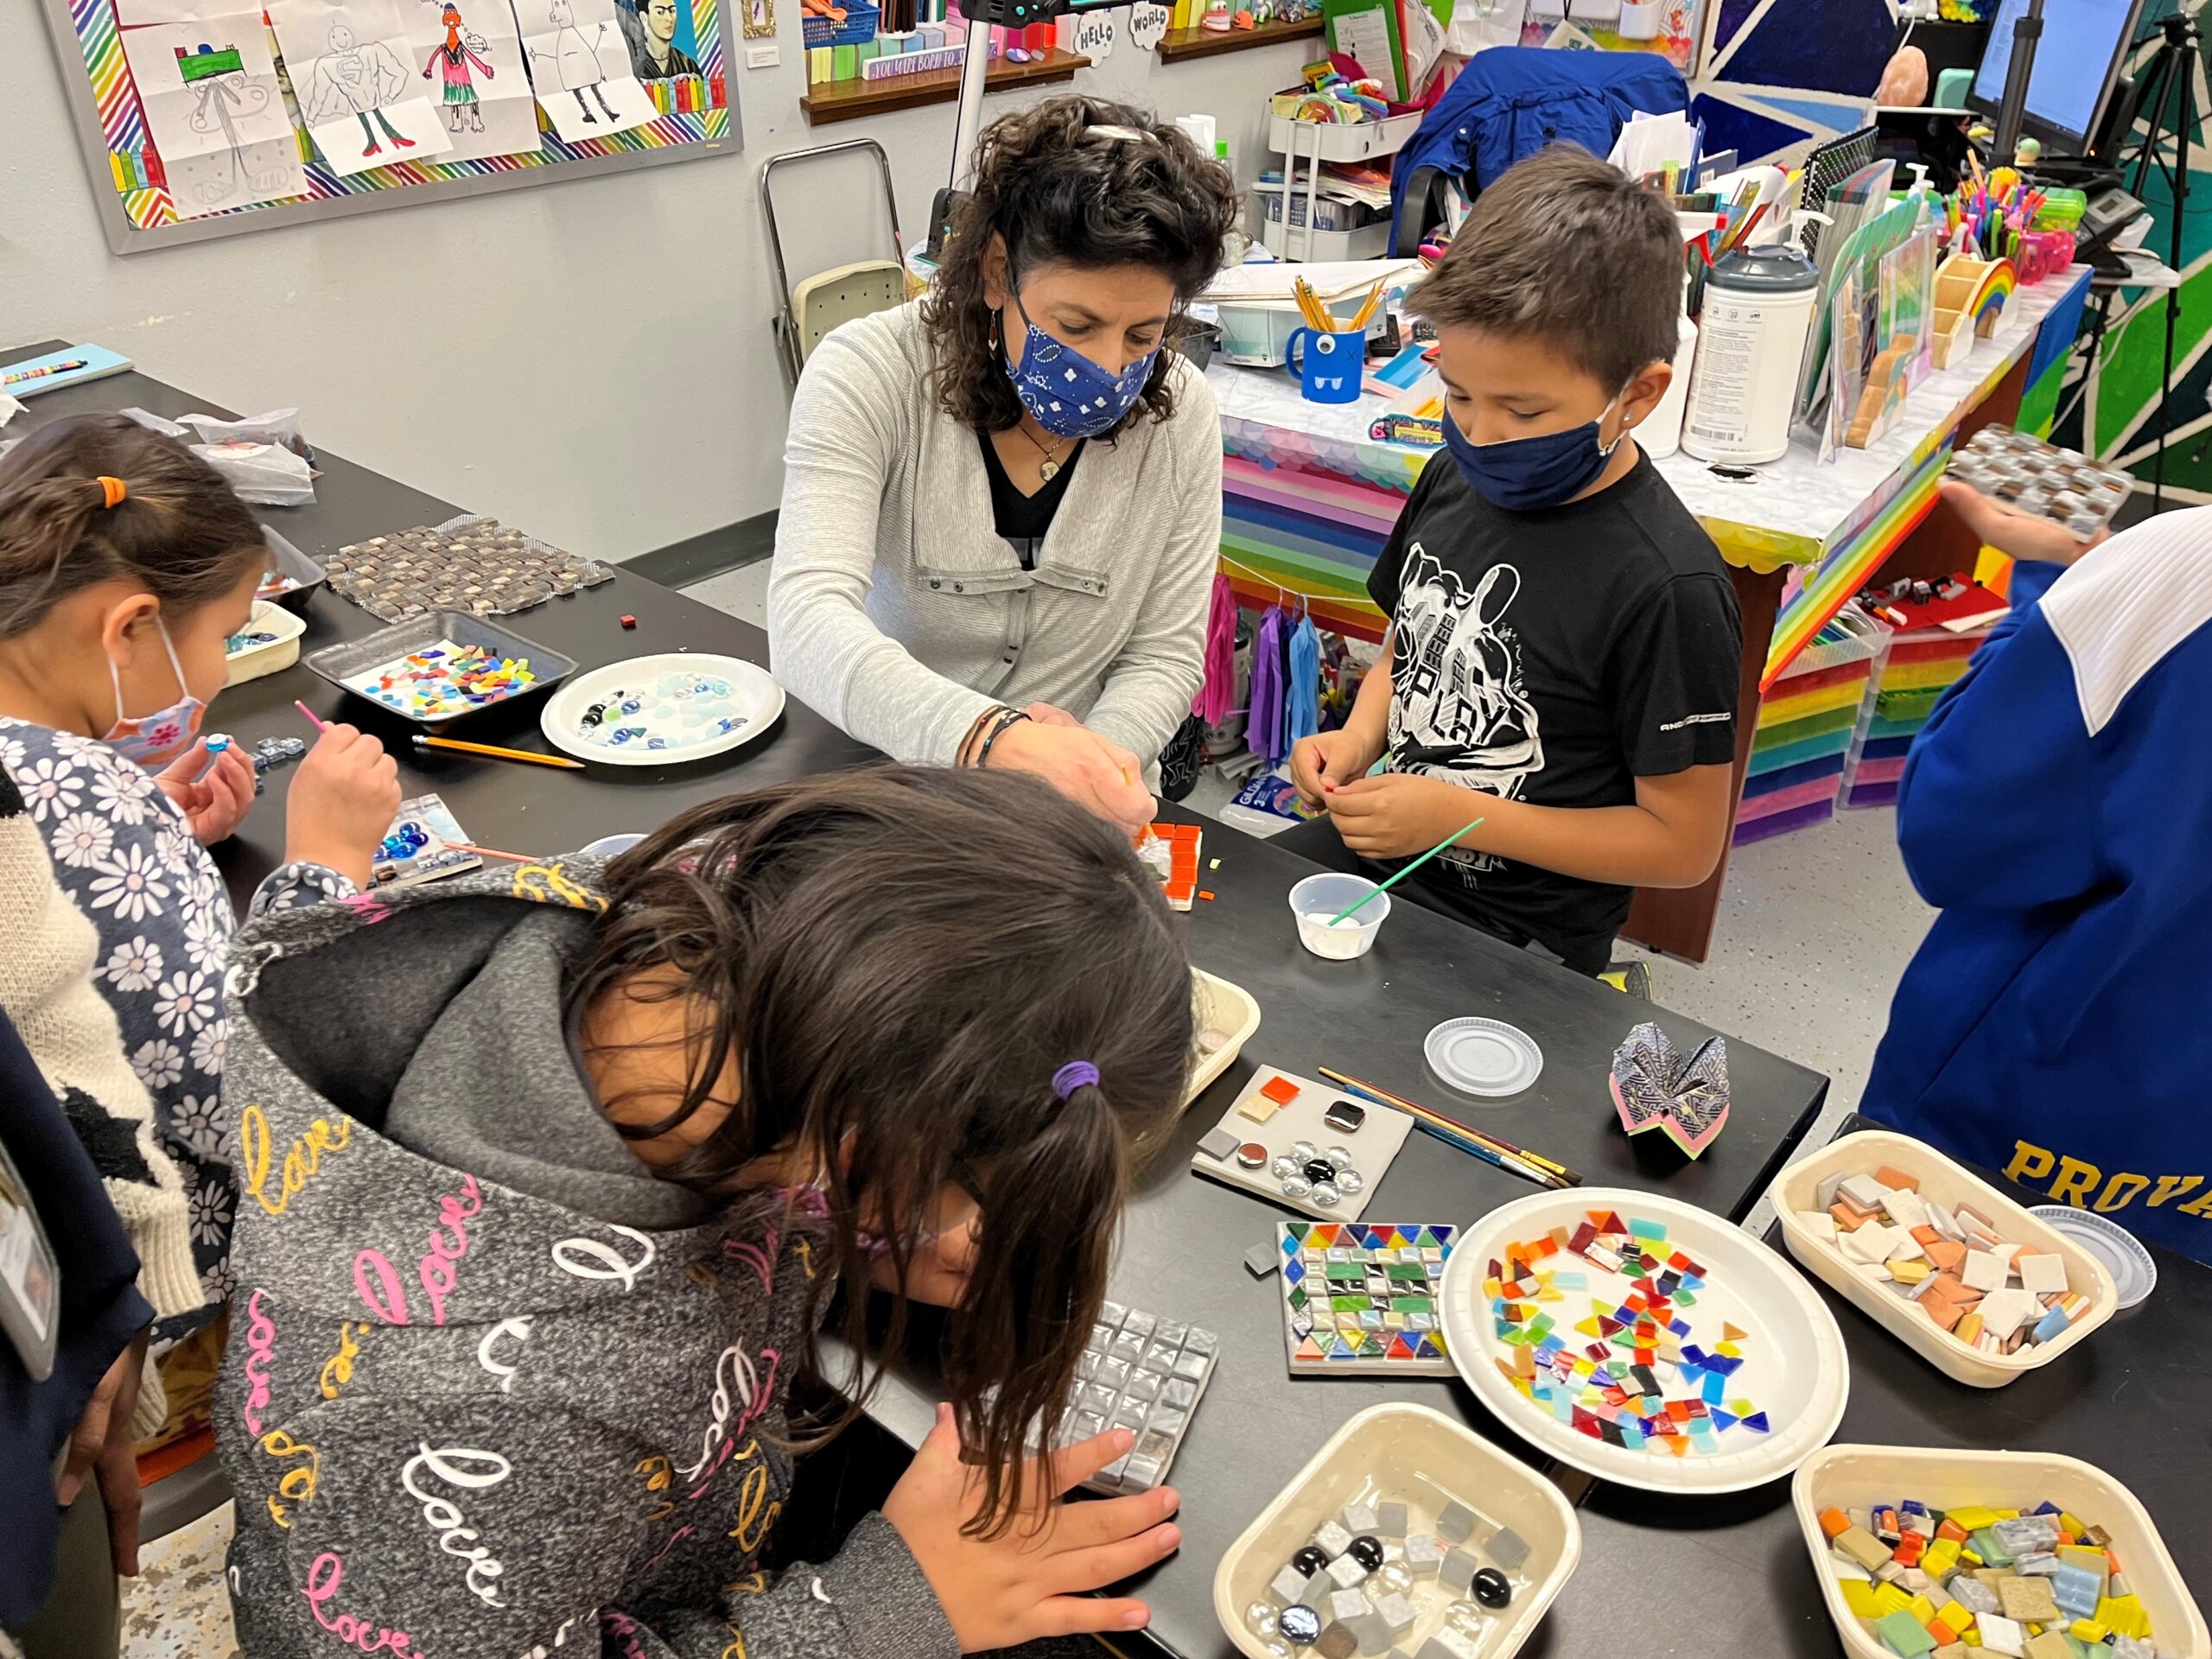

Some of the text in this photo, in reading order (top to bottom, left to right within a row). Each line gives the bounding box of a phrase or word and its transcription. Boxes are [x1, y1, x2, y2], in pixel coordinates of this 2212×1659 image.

[1080, 22, 1113, 49] HELLO
[1134, 9, 1166, 32] WORLD
[874, 62, 893, 79] YOU
[894, 56, 917, 75] WERE
[918, 53, 941, 72] BORN
[241, 1105, 351, 1215] love
[402, 1441, 512, 1607] love
[300, 1552, 425, 1659] love
